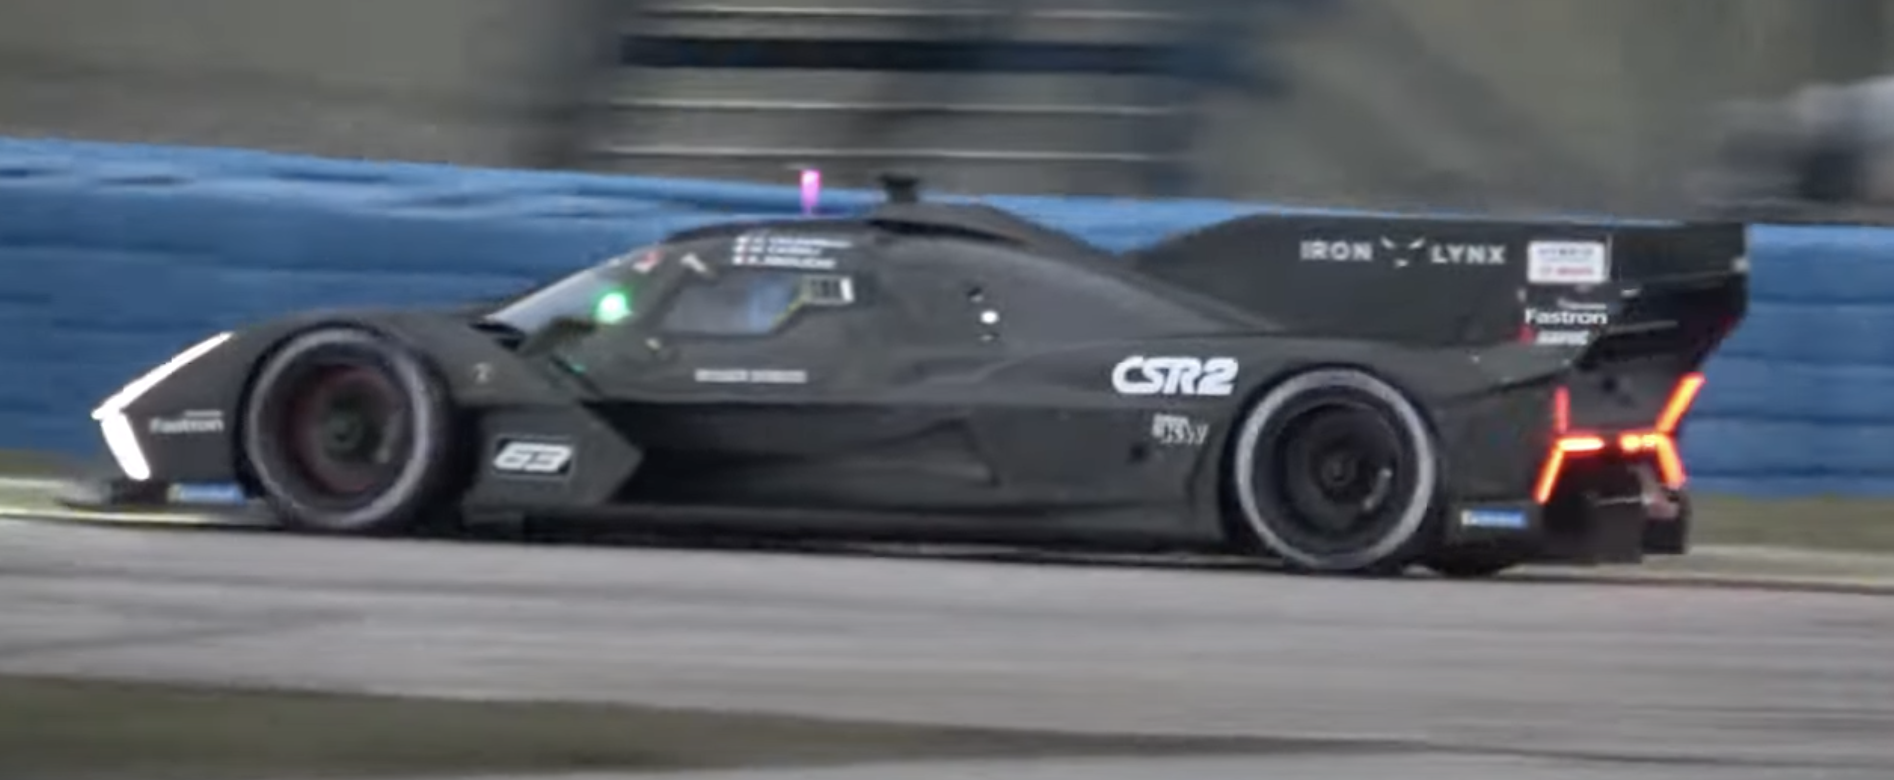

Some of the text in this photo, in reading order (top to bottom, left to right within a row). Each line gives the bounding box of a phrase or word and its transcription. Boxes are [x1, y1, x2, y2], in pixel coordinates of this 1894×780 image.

[1300, 240, 1506, 265] IRON LYNX
[1525, 308, 1608, 324] Fastron
[1111, 355, 1239, 395] CSR2
[493, 441, 571, 472] 63
